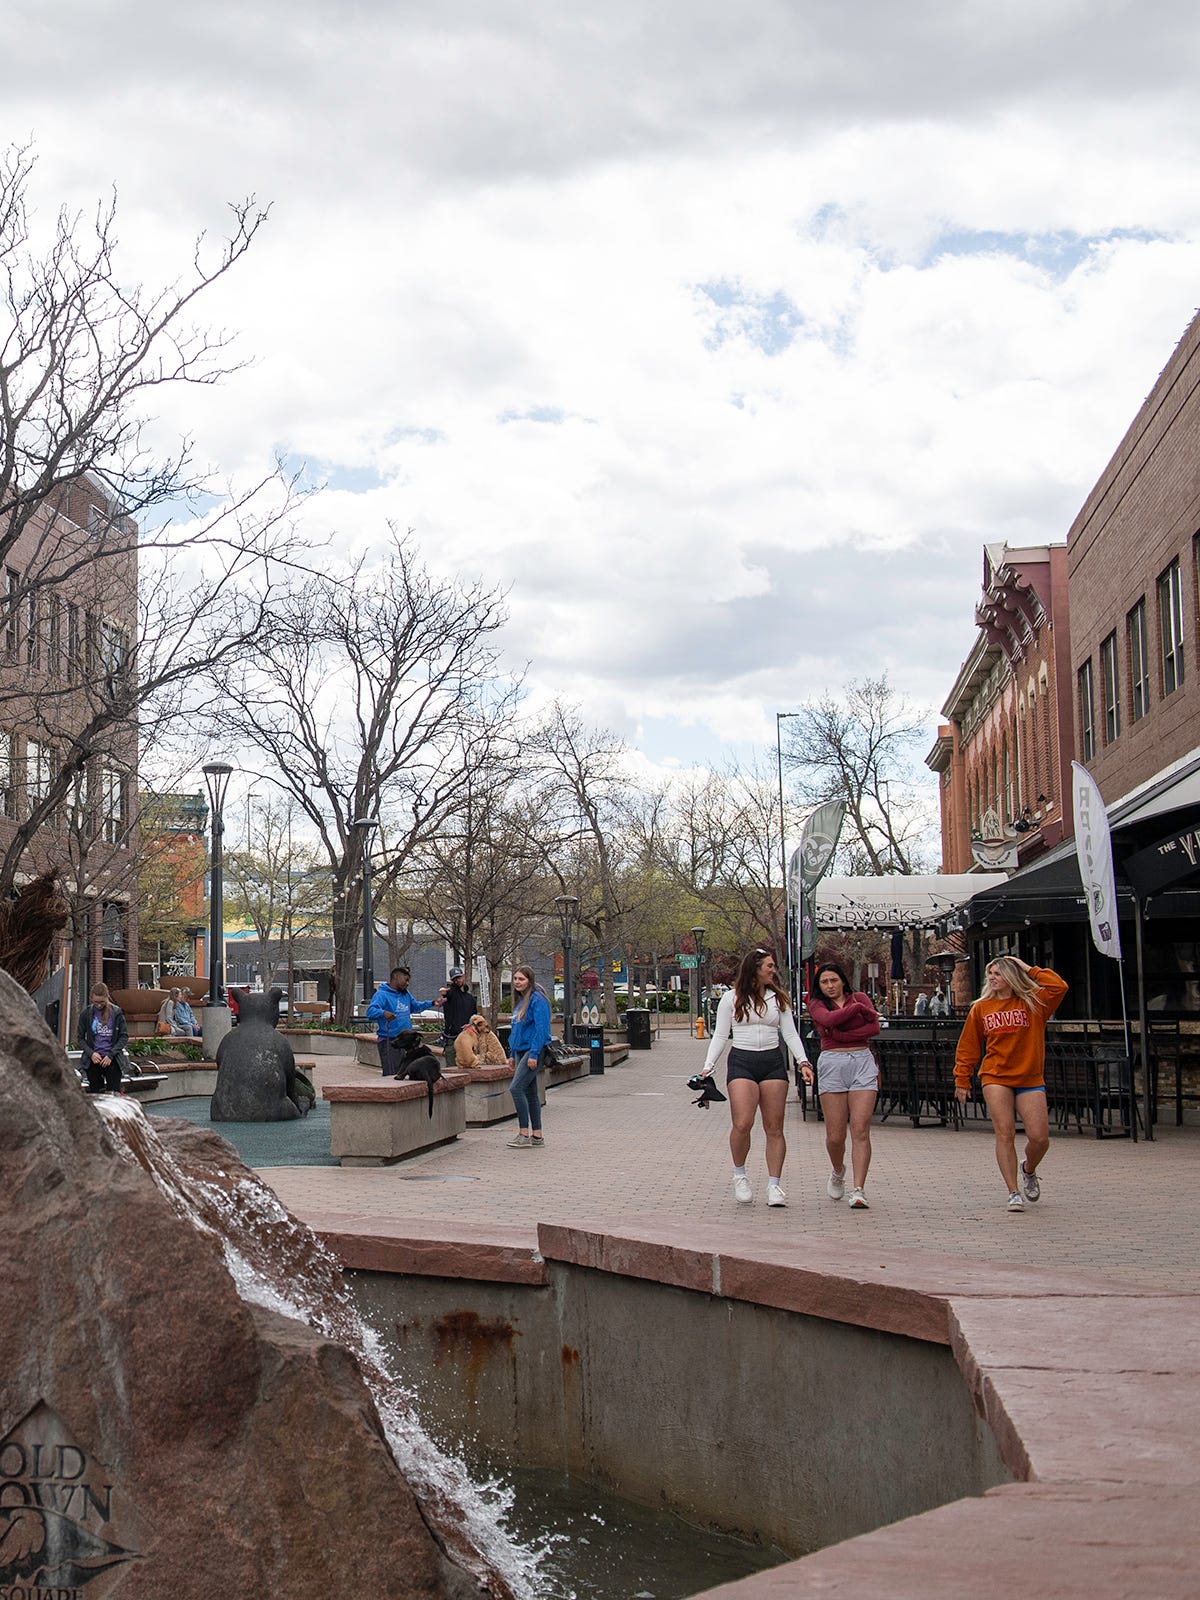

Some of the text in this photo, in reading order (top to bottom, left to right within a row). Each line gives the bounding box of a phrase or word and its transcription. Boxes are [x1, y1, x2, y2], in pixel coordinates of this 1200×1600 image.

[1157, 840, 1177, 855] THE
[856, 901, 900, 910] Mountain
[818, 909, 921, 923] OLDWORKS
